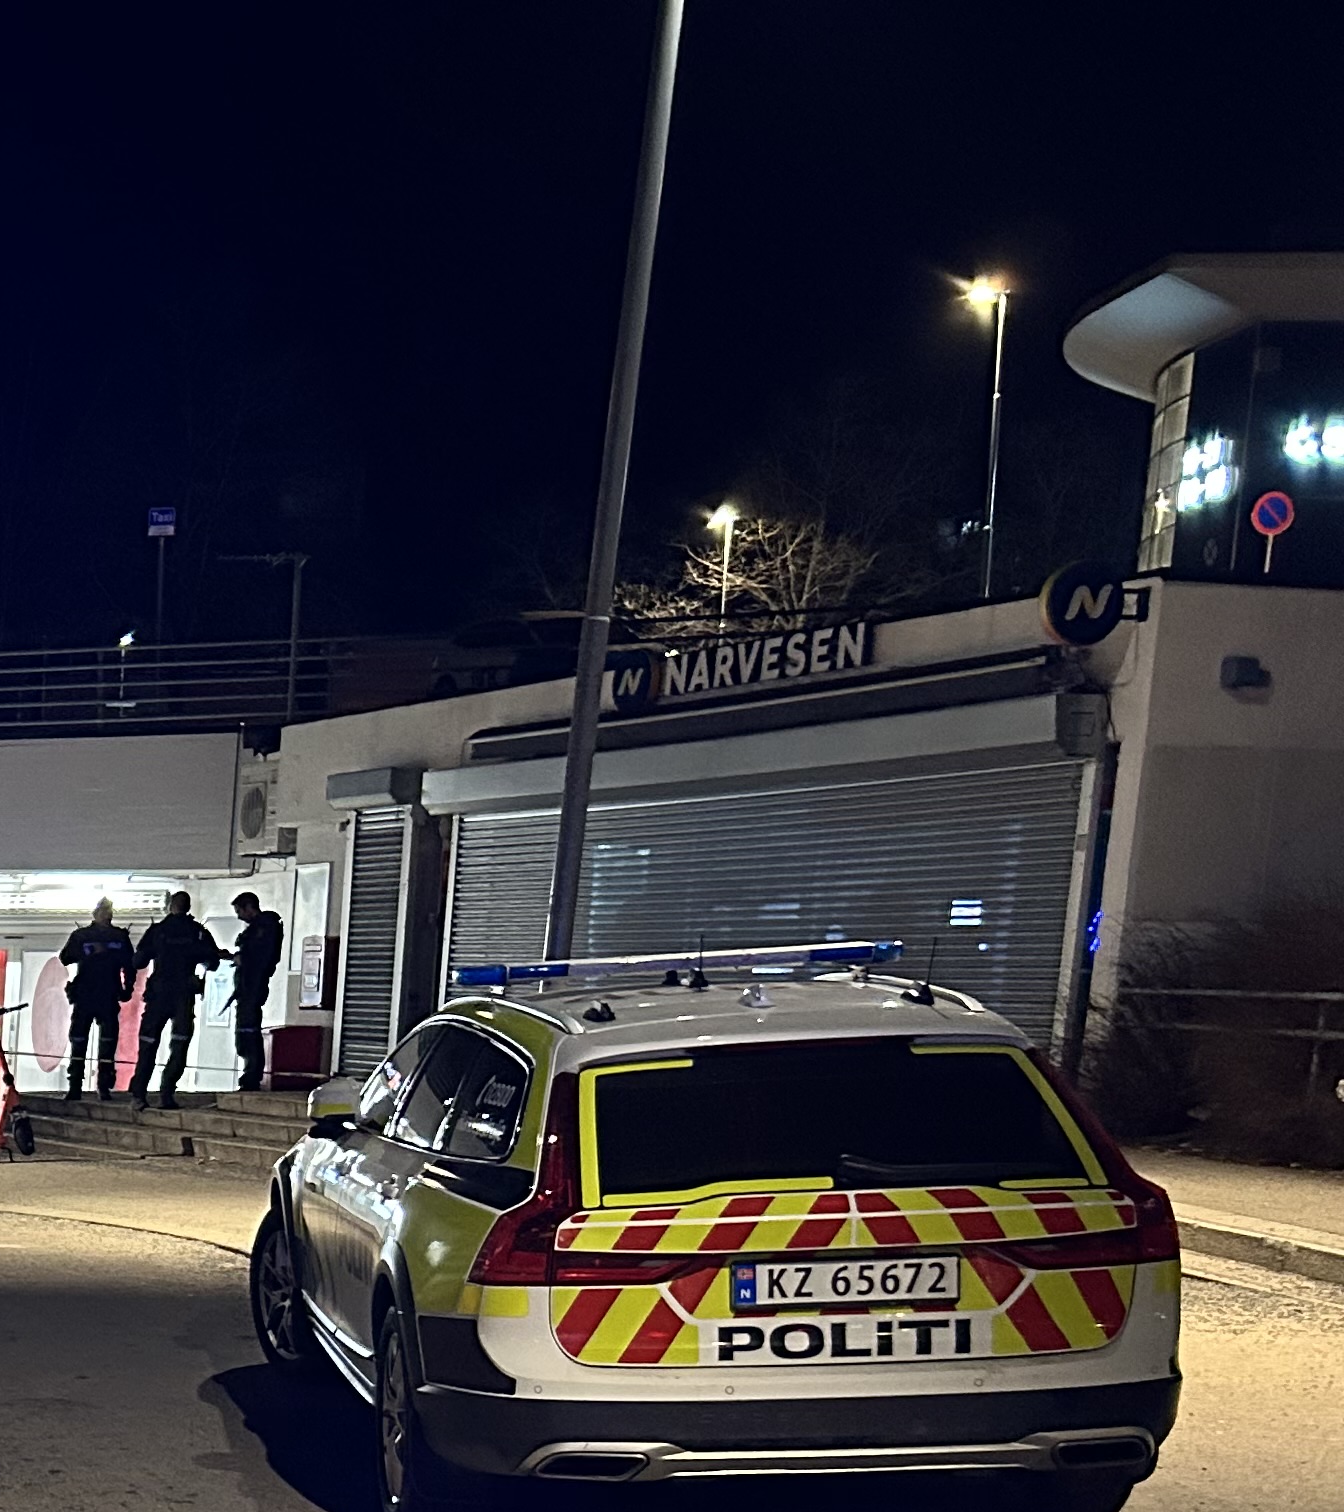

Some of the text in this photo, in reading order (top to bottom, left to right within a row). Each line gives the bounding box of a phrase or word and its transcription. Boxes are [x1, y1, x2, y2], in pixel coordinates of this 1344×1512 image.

[151, 511, 174, 523] Taxi
[663, 621, 865, 697] NARVESEN
[740, 1261, 947, 1299] N KZ 65672
[717, 1318, 972, 1361] POLITI
